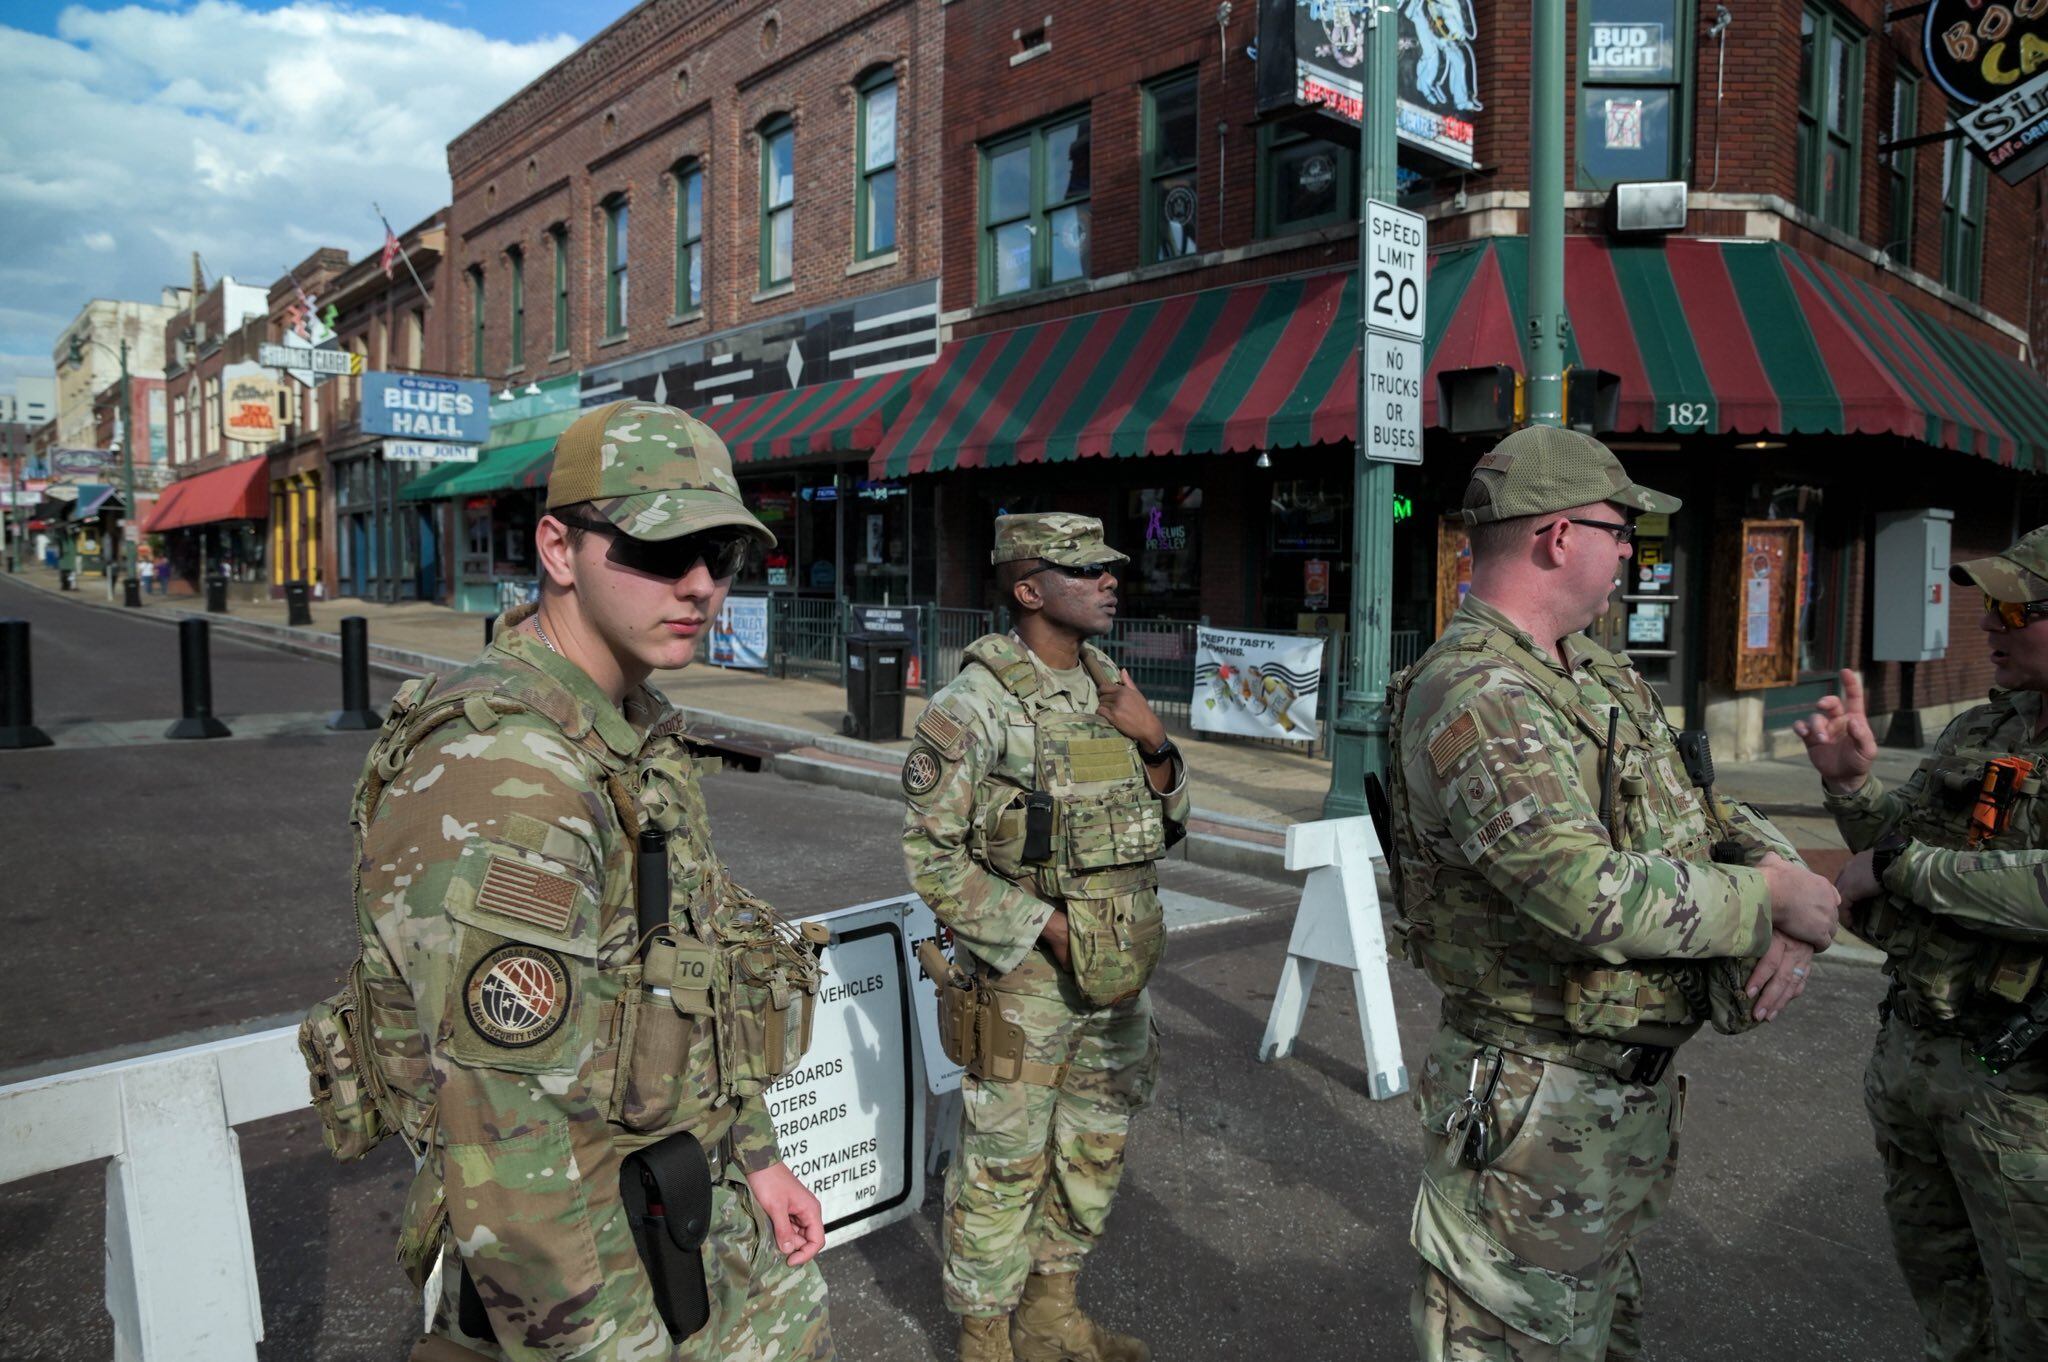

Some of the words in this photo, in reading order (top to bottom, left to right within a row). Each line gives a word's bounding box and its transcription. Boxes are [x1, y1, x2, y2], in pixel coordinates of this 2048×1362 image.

[1594, 27, 1648, 48] BUD
[1588, 47, 1657, 66] LIGHT
[1981, 32, 2048, 85] CA
[1373, 217, 1420, 247] SPEED
[1378, 244, 1415, 271] LIMIT
[1373, 269, 1418, 321] 20
[1386, 350, 1404, 371] NO
[1370, 373, 1418, 398] TRUCKS
[384, 387, 474, 415] BLUES
[1386, 402, 1403, 422] OR
[1667, 402, 1709, 426] 182
[392, 412, 463, 438] HALL
[1374, 425, 1415, 448] BUSES
[393, 445, 423, 457] JUKE
[434, 446, 469, 458] JOINT
[1226, 636, 1236, 645] IT
[1238, 638, 1276, 650] TASTY,
[1478, 811, 1514, 848] HARRIS
[527, 950, 563, 984] GUARDIANS
[680, 961, 705, 978] TQ
[820, 974, 884, 1005] VEHICLES
[484, 1023, 525, 1042] SECURITY
[527, 1014, 556, 1040] FORCES
[770, 1090, 818, 1118] OTERS
[781, 1139, 809, 1161] AYS
[791, 1138, 877, 1178] CONTAINERS
[813, 1160, 877, 1194] REPTILES
[855, 1185, 877, 1201] MPD
